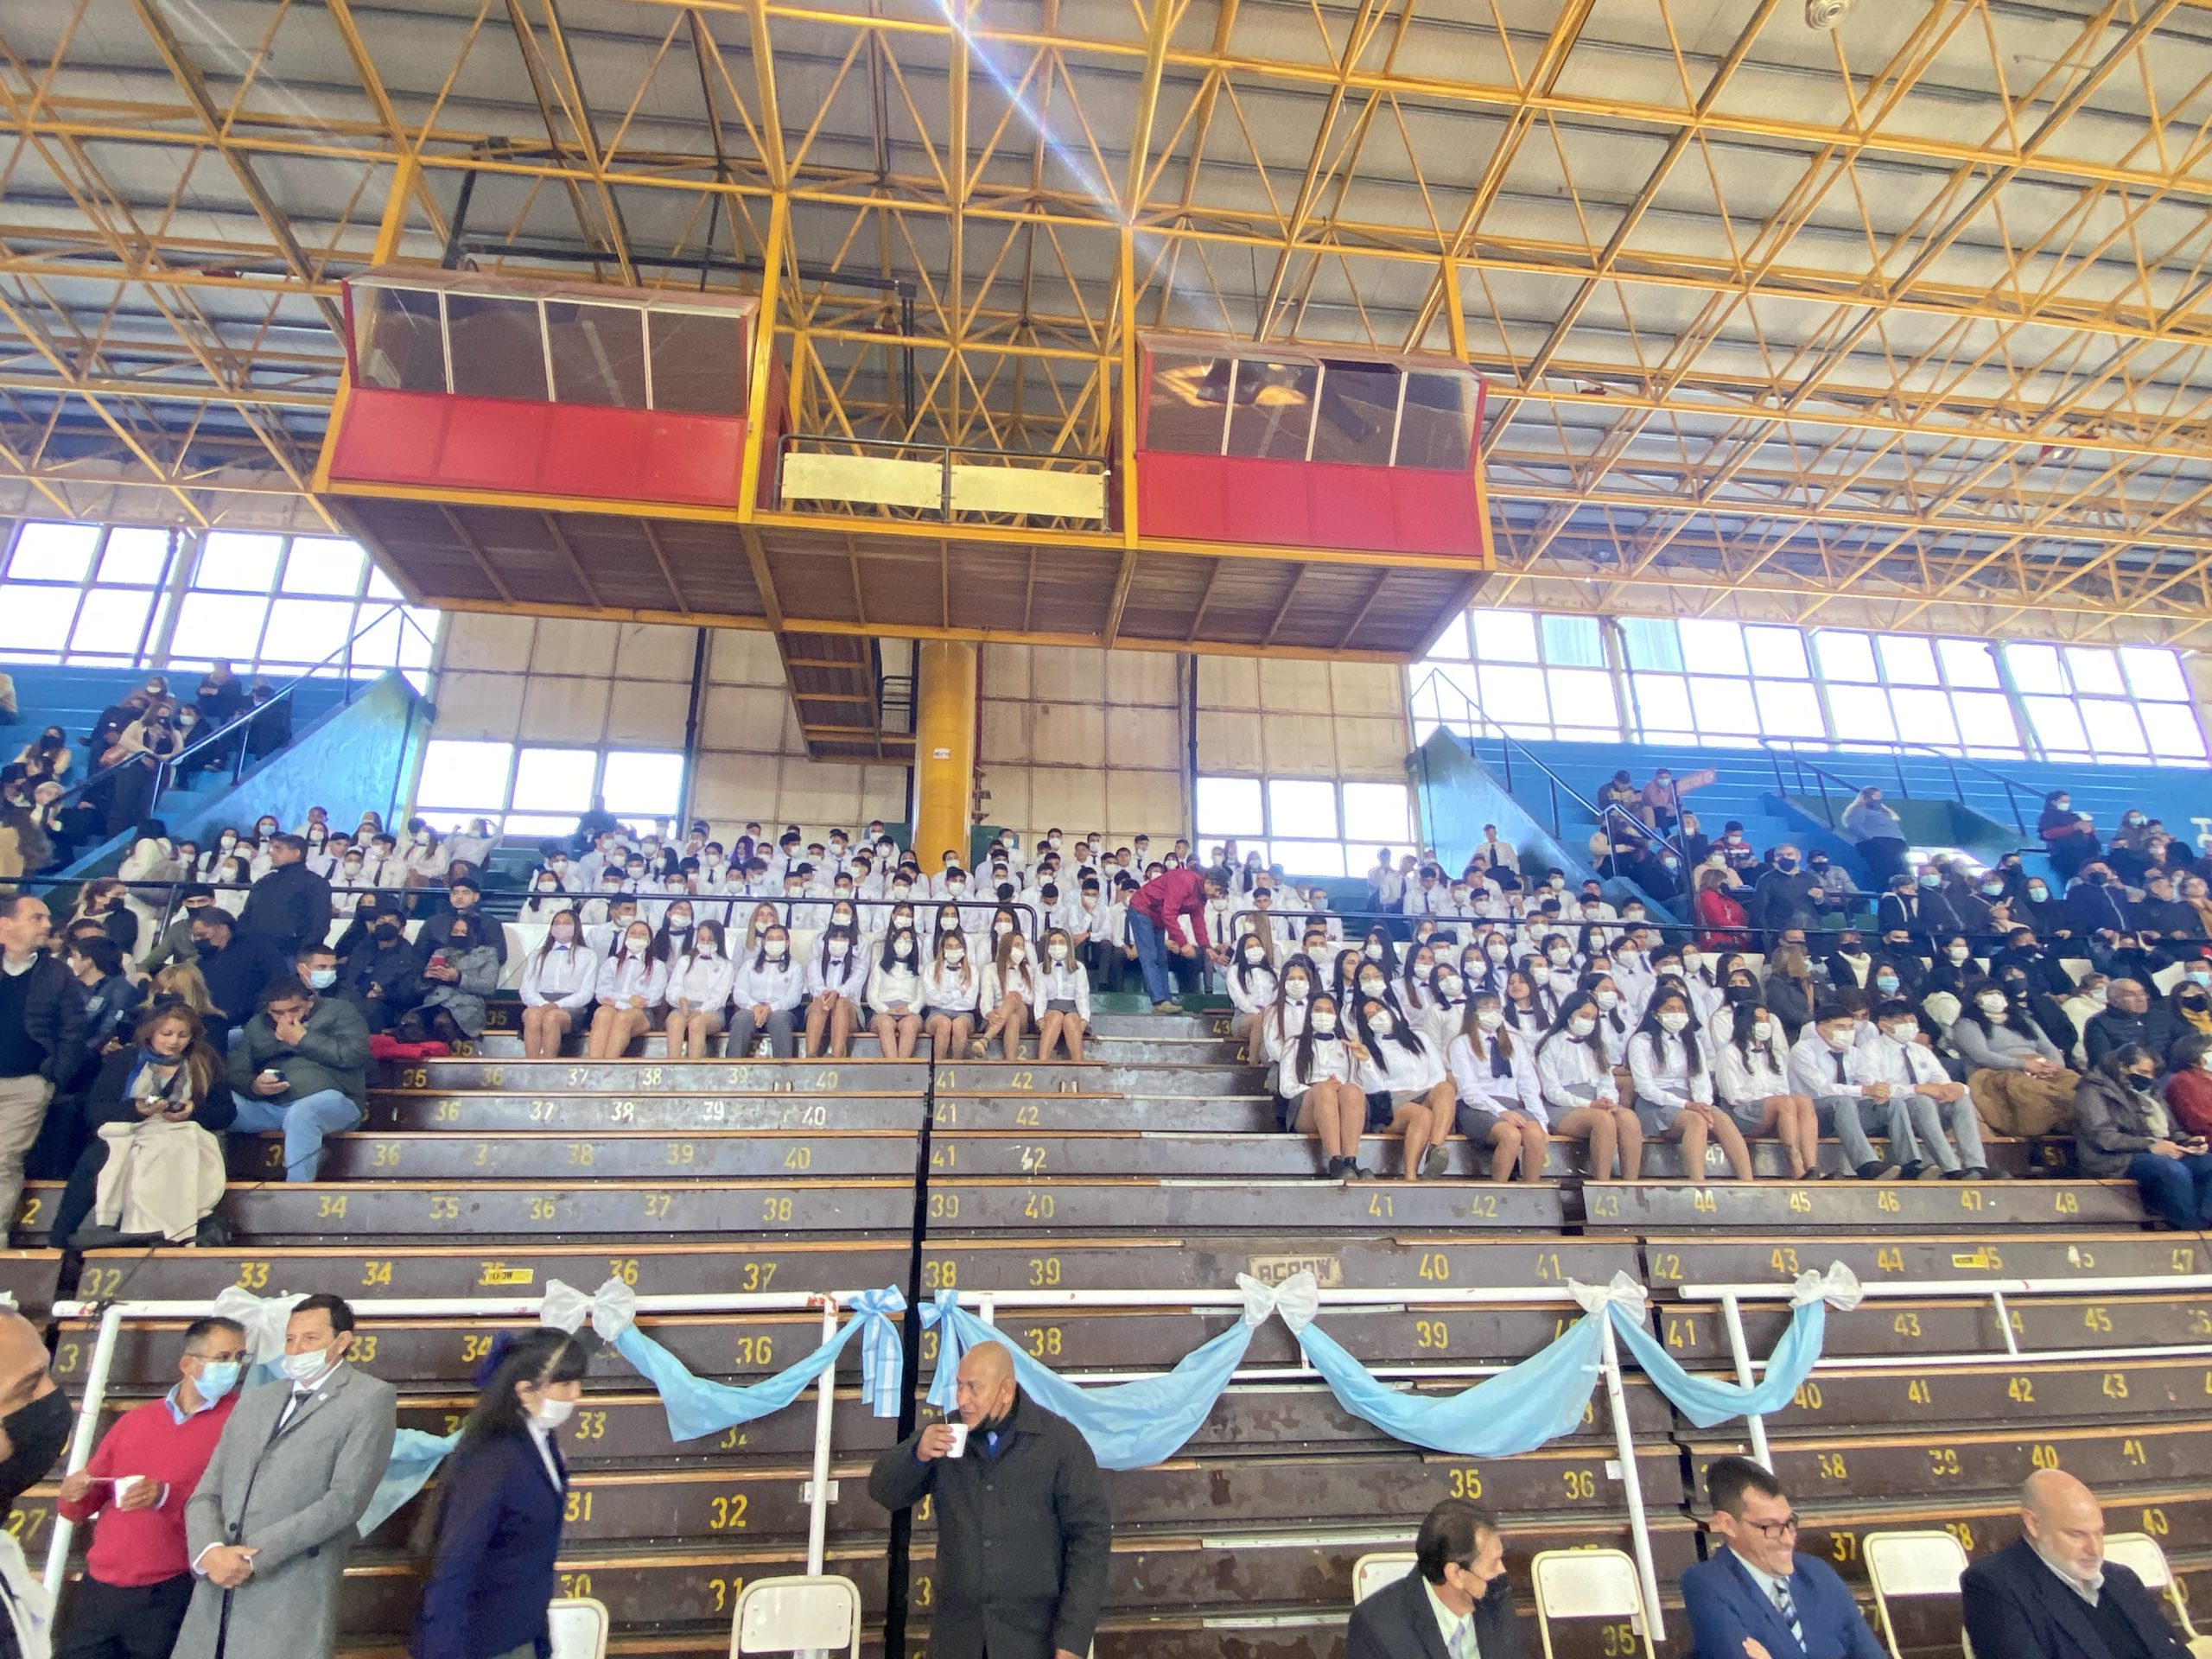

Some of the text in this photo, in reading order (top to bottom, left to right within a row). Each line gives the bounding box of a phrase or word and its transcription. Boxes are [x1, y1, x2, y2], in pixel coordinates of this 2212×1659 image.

[1213, 1020, 1230, 1034] 43
[569, 1068, 589, 1085] 37
[643, 1068, 662, 1085] 38
[728, 1067, 748, 1084] 39
[816, 1071, 838, 1089] 40
[936, 1071, 955, 1088] 41
[1012, 1071, 1033, 1090] 42
[435, 1101, 461, 1121] 36
[530, 1101, 554, 1120] 37
[702, 1101, 724, 1121] 39
[802, 1107, 826, 1126] 40
[936, 1103, 956, 1123] 41
[1016, 1106, 1039, 1126] 42
[266, 1145, 284, 1166] 3
[372, 1145, 401, 1166] 36
[568, 1145, 594, 1165] 38
[667, 1144, 693, 1165] 39
[784, 1147, 810, 1169] 40
[932, 1145, 955, 1166] 41
[1021, 1147, 1046, 1170] 42
[1705, 1146, 1725, 1166] 47
[317, 1195, 347, 1217] 34
[429, 1197, 460, 1219] 35
[530, 1198, 556, 1219] 36
[645, 1194, 671, 1217] 37
[763, 1198, 792, 1221] 38
[931, 1194, 959, 1218] 39
[1025, 1194, 1054, 1218] 40
[1369, 1193, 1393, 1217] 41
[1472, 1195, 1498, 1217] 42
[1594, 1196, 1618, 1217] 43
[1694, 1190, 1716, 1212] 44
[1790, 1192, 1811, 1211] 45
[1878, 1191, 1900, 1211] 46
[1961, 1191, 1982, 1211] 47
[2056, 1192, 2079, 1213] 48
[1419, 1253, 1449, 1280] 40
[1535, 1255, 1560, 1280] 41
[1655, 1255, 1682, 1279] 42
[1771, 1248, 1799, 1273] 43
[1878, 1246, 1905, 1272] 44
[2171, 1249, 2193, 1273] 47
[84, 1268, 122, 1297] 32
[236, 1262, 270, 1288] 33
[361, 1262, 392, 1285] 34
[743, 1262, 776, 1291] 37
[925, 1261, 957, 1288] 38
[1028, 1257, 1061, 1286] 39
[1894, 1313, 1922, 1337] 43
[2084, 1308, 2112, 1332] 45
[1028, 1327, 1062, 1357] 38
[1416, 1320, 1448, 1349] 39
[1669, 1319, 1696, 1348] 41
[346, 1336, 378, 1363] 33
[461, 1336, 493, 1363] 34
[735, 1336, 772, 1364] 36
[1794, 1383, 1821, 1409] 40
[1908, 1379, 1930, 1404] 41
[2008, 1377, 2035, 1402] 42
[2103, 1374, 2128, 1398] 43
[575, 1412, 606, 1440] 33
[1817, 1453, 1847, 1479] 38
[2032, 1444, 2059, 1469] 40
[1449, 1469, 1482, 1499] 35
[1563, 1471, 1596, 1500] 36
[564, 1492, 592, 1522] 31
[709, 1494, 747, 1529] 32
[1829, 1532, 1856, 1561] 37
[1602, 1624, 1636, 1656] 35
